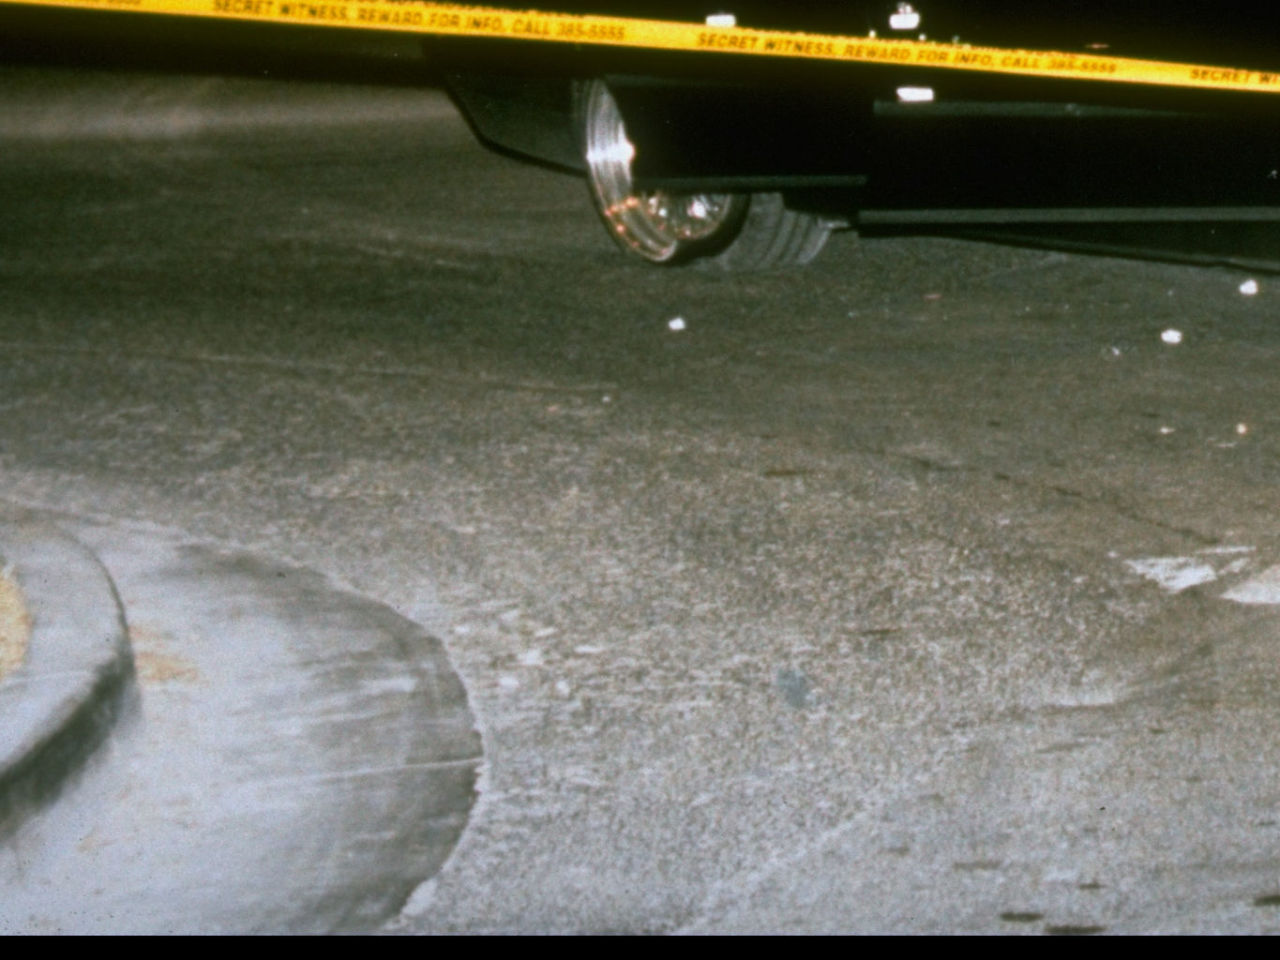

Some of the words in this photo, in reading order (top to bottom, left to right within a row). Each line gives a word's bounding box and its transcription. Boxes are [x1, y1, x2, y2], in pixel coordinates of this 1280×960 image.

[357, 6, 424, 26] REWARD
[429, 11, 461, 29] FOR
[512, 18, 551, 36] CALL
[697, 31, 759, 50] SECRET
[842, 42, 911, 61] REWARD
[916, 47, 949, 63] FOR
[1001, 54, 1041, 70] CALL
[1189, 67, 1252, 83] SECRET
